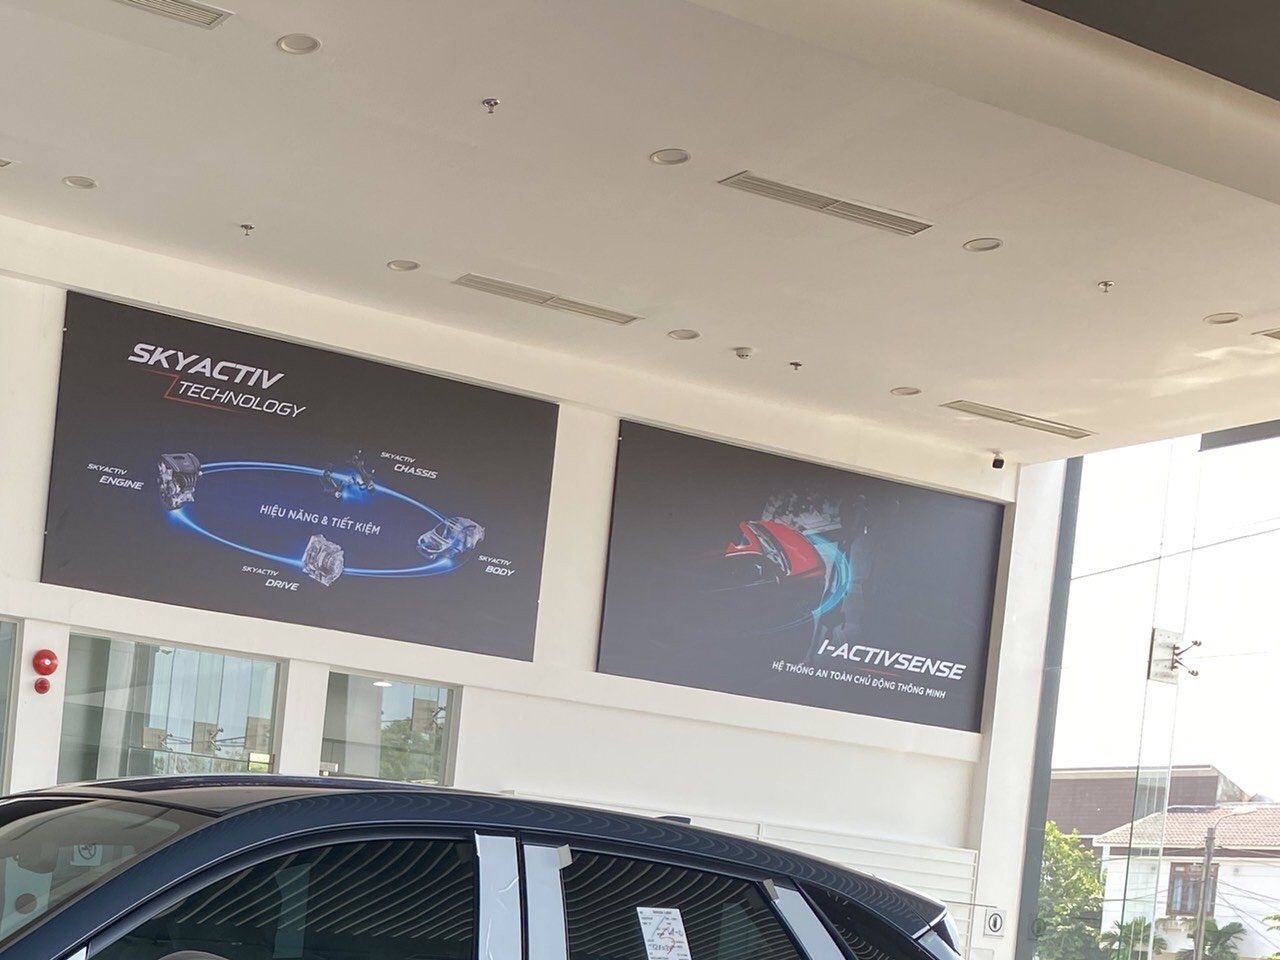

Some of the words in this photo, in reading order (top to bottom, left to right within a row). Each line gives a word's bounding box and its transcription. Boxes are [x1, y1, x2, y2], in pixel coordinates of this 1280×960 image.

[128, 343, 285, 389] SKYACTIV
[178, 381, 306, 418] TECHNOLOGY
[99, 475, 144, 490] ENGINE
[394, 463, 438, 480] CHASSIS
[260, 504, 287, 518] HIỆU
[287, 509, 319, 524] NĂNG
[321, 516, 329, 525] &
[331, 516, 354, 530] TIẾT
[355, 521, 381, 535] KIỆM
[265, 579, 299, 591] DRIVE
[485, 565, 516, 577] BODY
[817, 639, 967, 680] I-ACTIVSENSE
[772, 661, 784, 672] HỆ
[786, 663, 815, 676] THỐNG
[815, 669, 828, 678] AN
[830, 670, 852, 683] TOÀN
[854, 674, 871, 686] CHỦ
[872, 677, 896, 690] ĐỘNG
[897, 683, 924, 695] THÔNG
[925, 689, 947, 699] MINH
